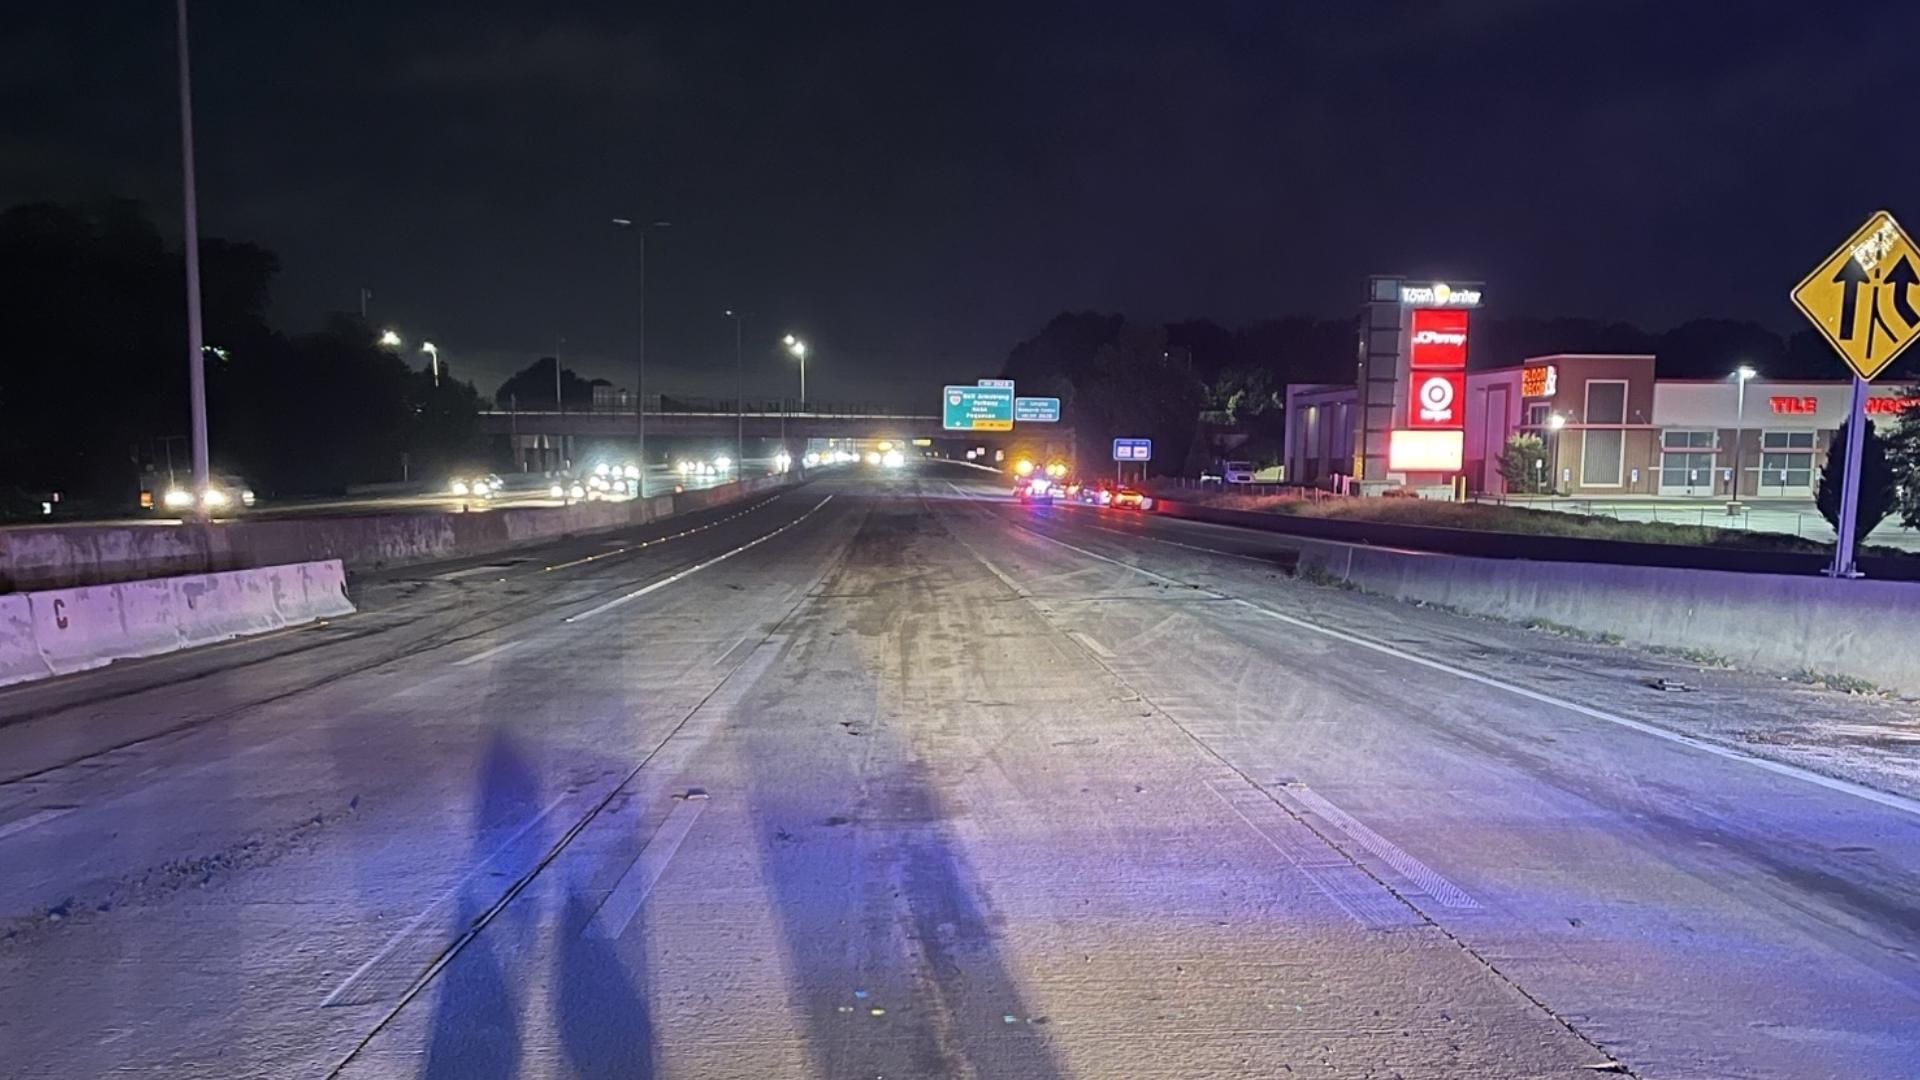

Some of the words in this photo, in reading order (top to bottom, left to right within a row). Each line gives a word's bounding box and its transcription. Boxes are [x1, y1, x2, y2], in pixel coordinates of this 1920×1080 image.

[1402, 288, 1433, 303] Town
[1411, 331, 1467, 346] JCPenney
[1769, 396, 1818, 414] TILE
